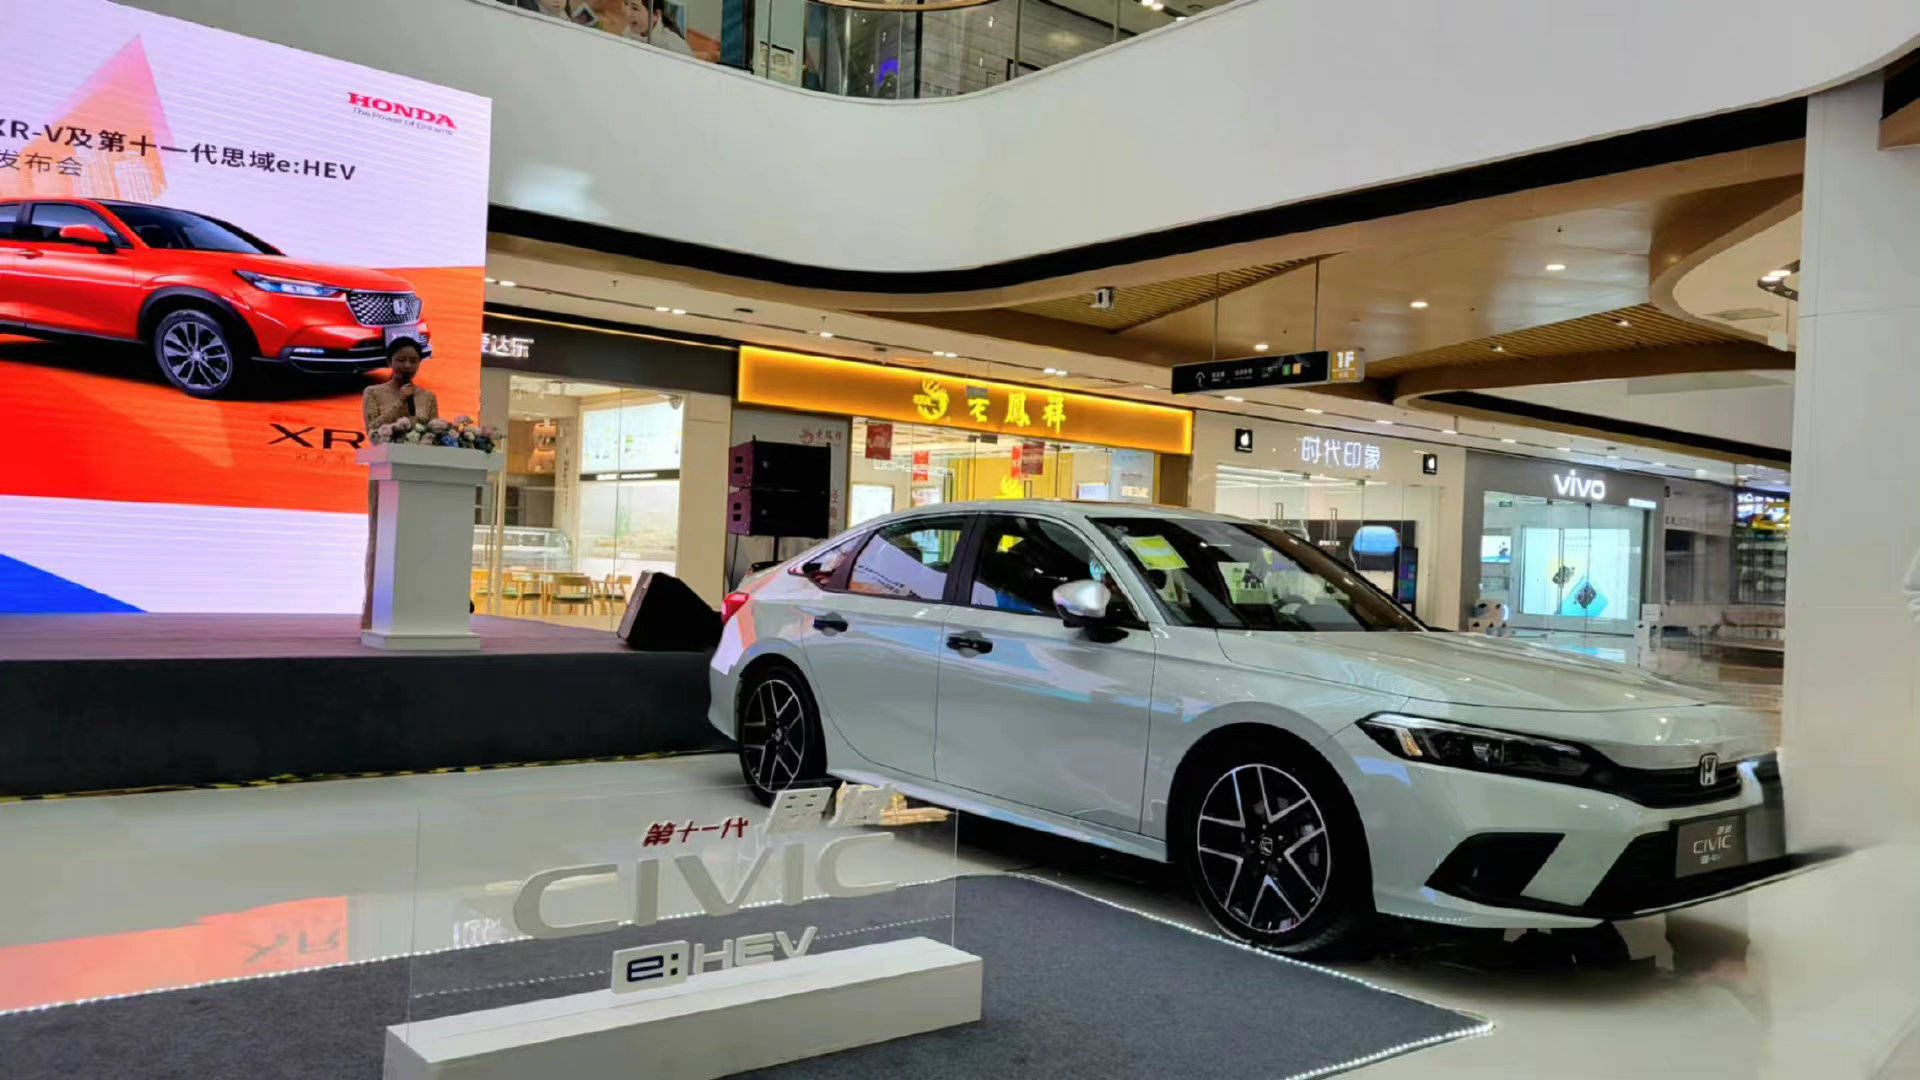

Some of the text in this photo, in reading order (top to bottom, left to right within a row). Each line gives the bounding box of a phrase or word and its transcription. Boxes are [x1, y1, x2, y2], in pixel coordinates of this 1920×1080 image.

[348, 92, 457, 129] HONDA
[0, 148, 83, 178] 发布会
[1337, 351, 1355, 369] 1F
[1300, 435, 1382, 470] 时代印象
[1553, 469, 1607, 500] vivo
[641, 816, 749, 848] 第十一代
[1693, 834, 1733, 854] CIVIC
[512, 831, 899, 940] CIVIC
[626, 926, 818, 983] e:HEV
